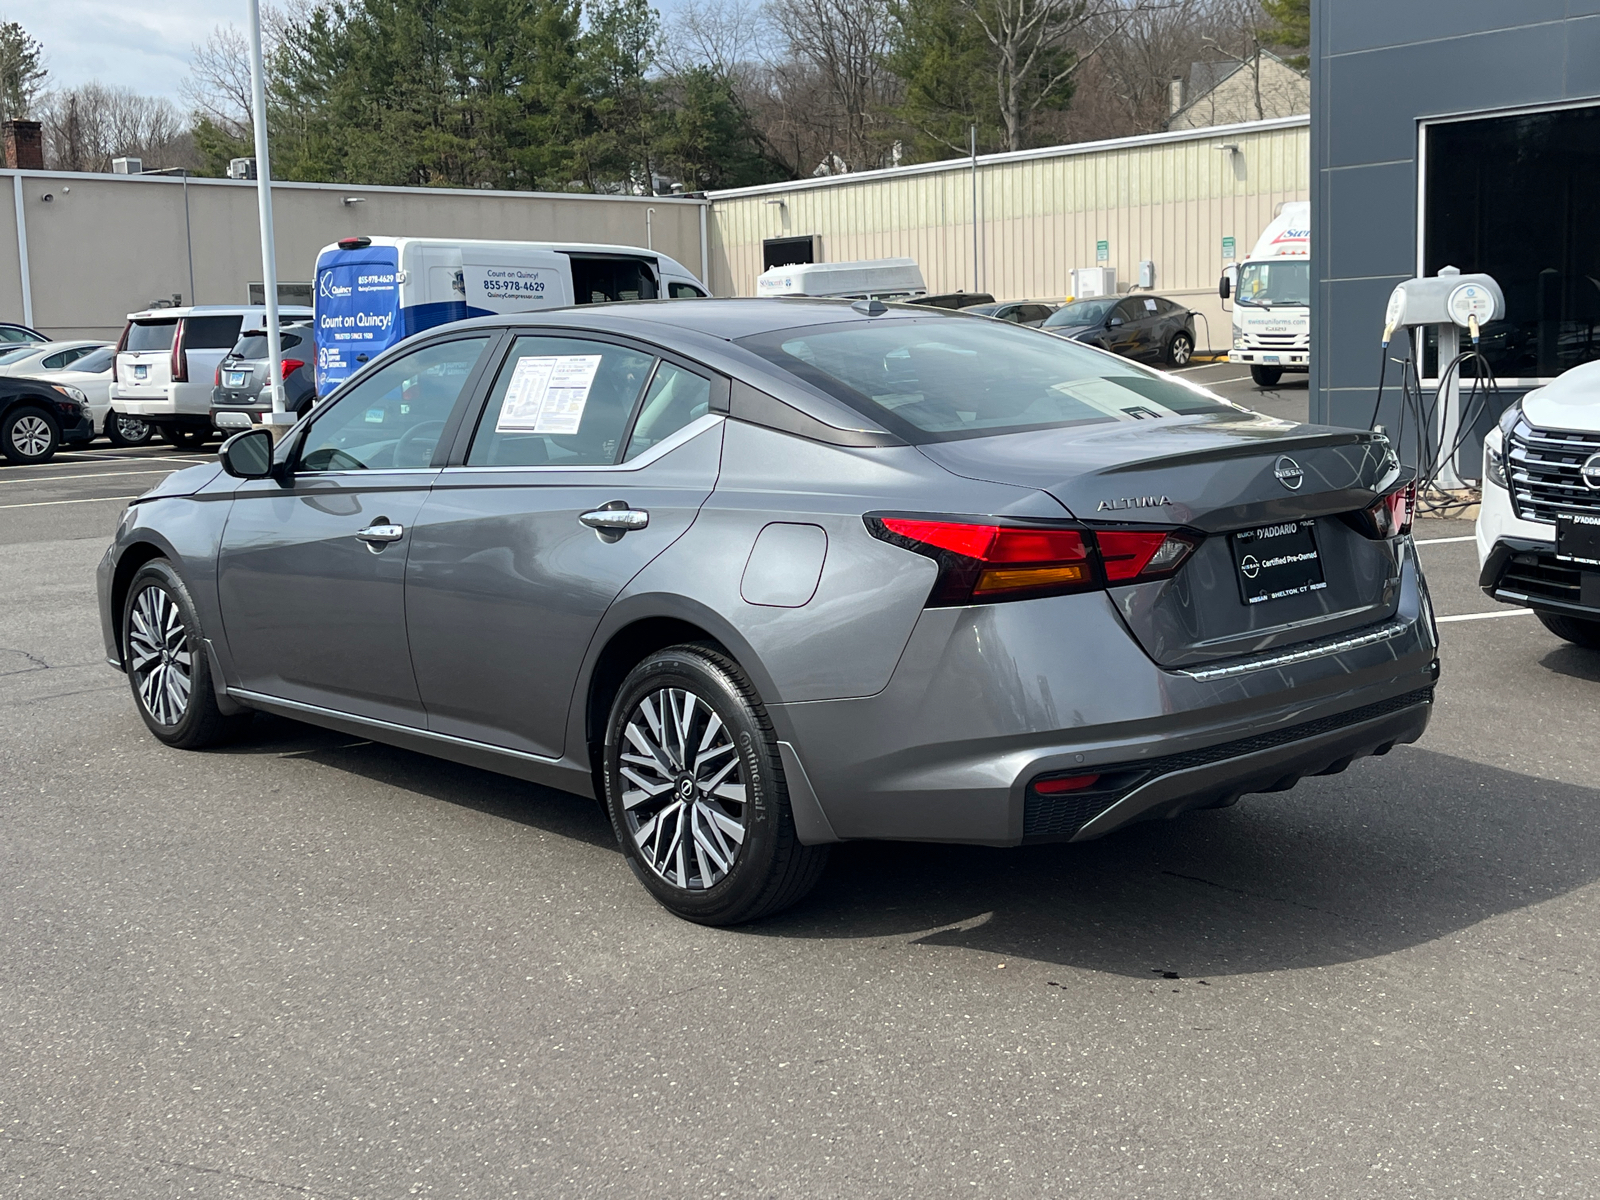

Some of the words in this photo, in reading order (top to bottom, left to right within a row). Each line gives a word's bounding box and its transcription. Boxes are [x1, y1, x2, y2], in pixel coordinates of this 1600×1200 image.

[358, 275, 394, 284] 855-978-4629
[487, 269, 506, 278] Count
[516, 271, 539, 280] Quincy!
[332, 286, 352, 294] Quincy
[483, 280, 545, 291] 855-978-4629
[321, 314, 342, 328] Count
[344, 316, 354, 327] on
[356, 311, 392, 330] Quincy!
[1248, 318, 1306, 326] swissuniforms.com
[1274, 468, 1304, 479] NISSAN
[1097, 495, 1173, 512] ALTIMA
[1257, 523, 1297, 539] D'ADDARIO
[1262, 556, 1286, 568] Certified
[1287, 551, 1318, 563] Pre-Owned
[1271, 589, 1299, 599] SHELTON,
[740, 731, 766, 811] Continental
